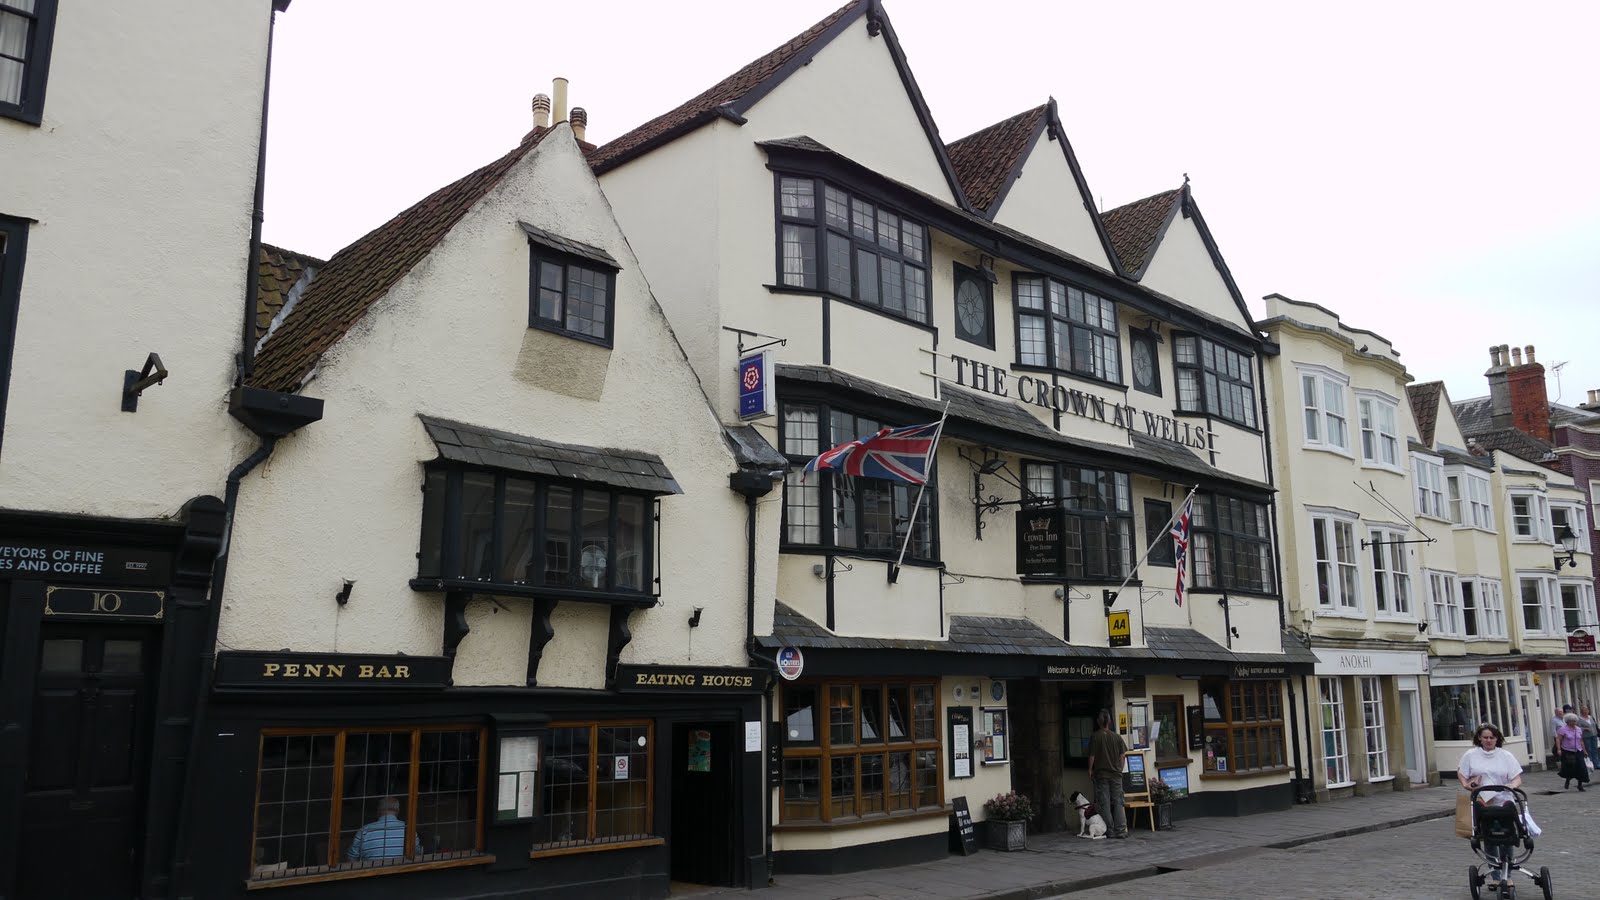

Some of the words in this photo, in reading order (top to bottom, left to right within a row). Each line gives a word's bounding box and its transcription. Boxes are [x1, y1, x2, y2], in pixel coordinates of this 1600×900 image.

[951, 354, 1008, 397] THE
[1017, 375, 1106, 423] CROWN
[1112, 402, 1137, 430] AT
[1142, 410, 1205, 450] WELLS
[1023, 532, 1044, 543] Crown
[1046, 531, 1058, 542] Inn
[52, 550, 71, 560] OF
[75, 551, 104, 563] FINE
[17, 560, 50, 571] AND
[53, 562, 102, 574] COFFEE
[92, 592, 121, 612] 10
[1113, 619, 1126, 630] AA
[1340, 654, 1372, 669] ANOKHI
[264, 663, 345, 678] PENN
[358, 665, 410, 678] BAR
[1047, 665, 1069, 674] Welcome
[1070, 666, 1076, 674] to
[1081, 664, 1102, 677] Crown
[636, 674, 696, 686] EATING
[702, 675, 753, 687] HOUSE
